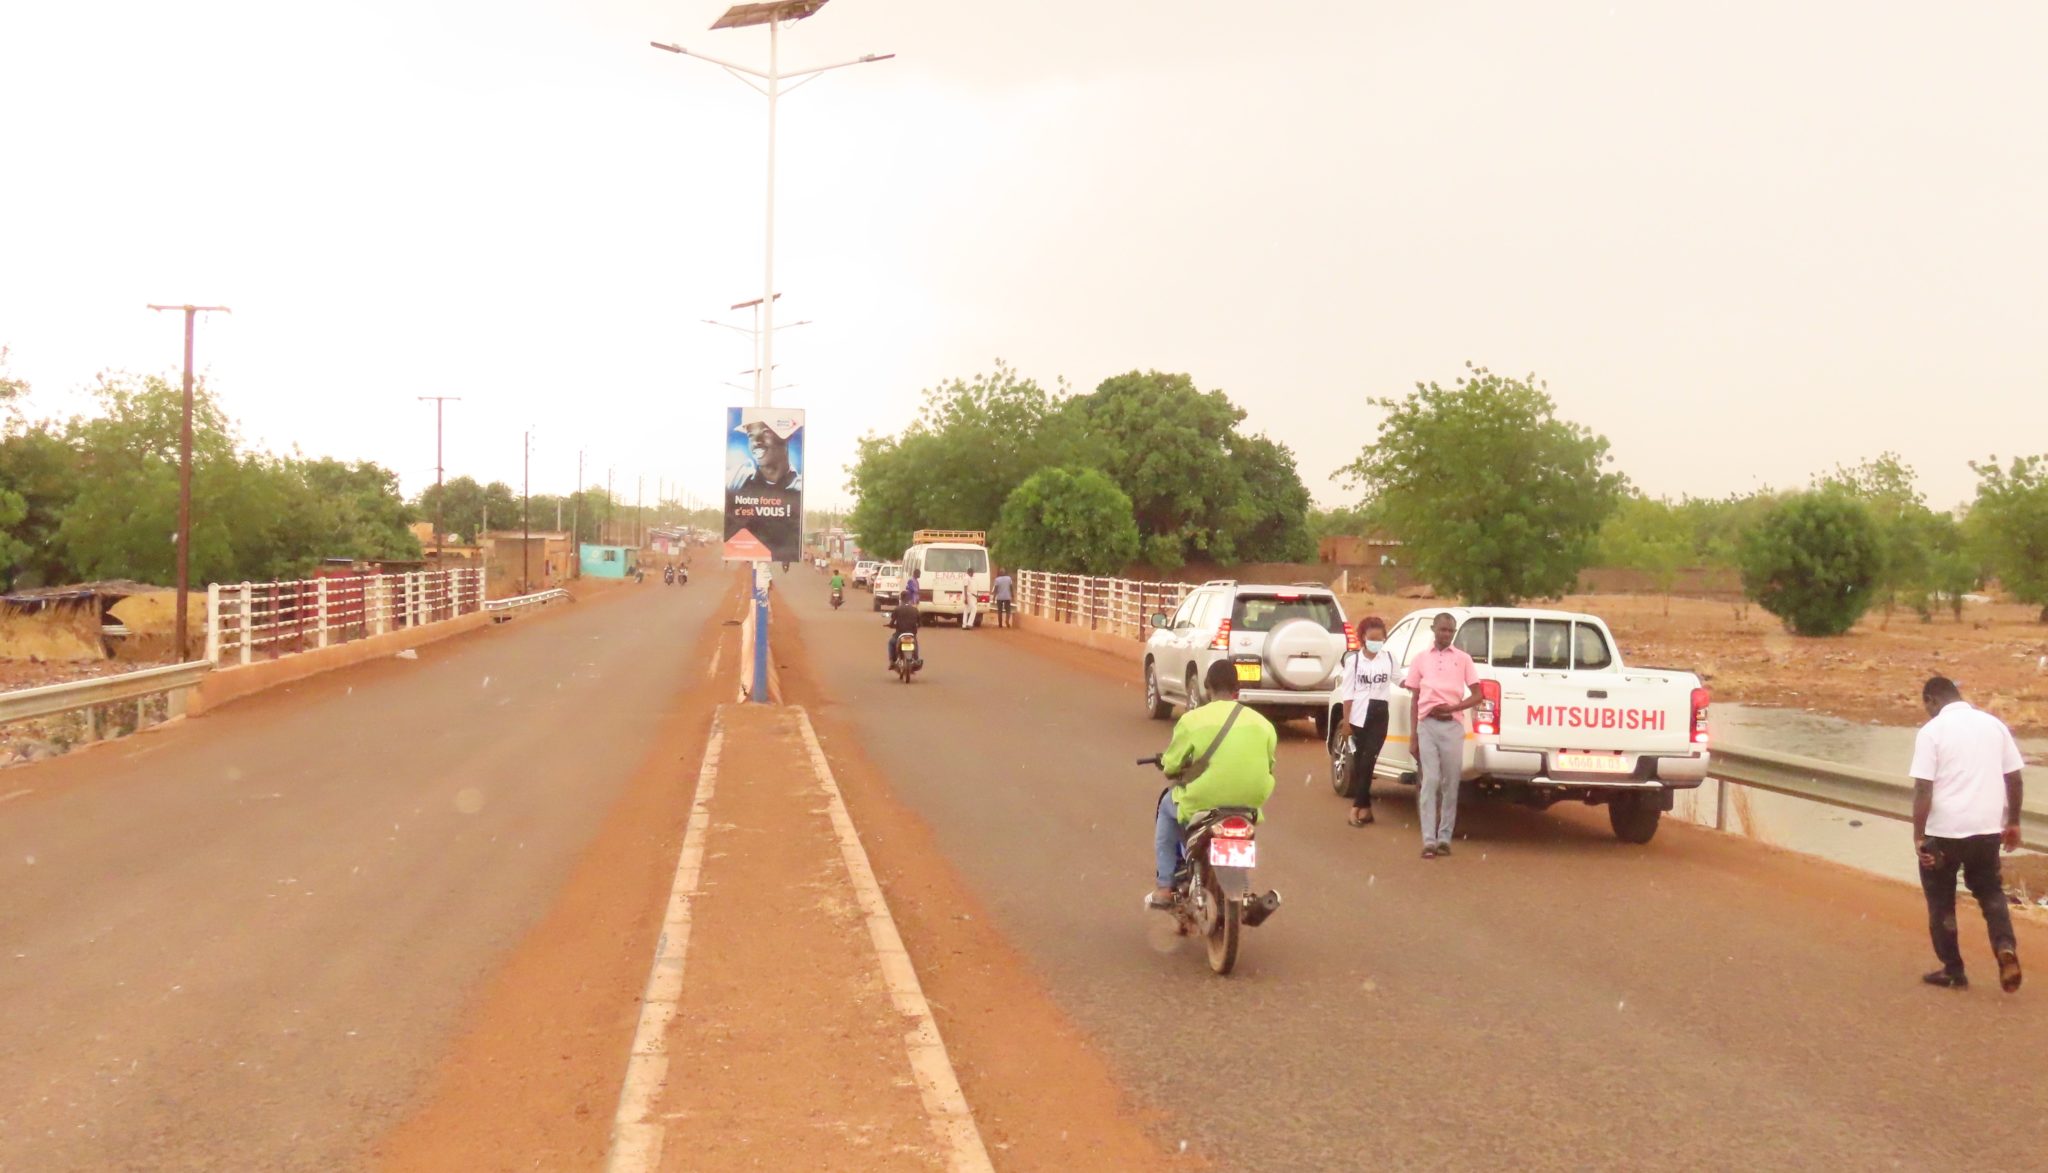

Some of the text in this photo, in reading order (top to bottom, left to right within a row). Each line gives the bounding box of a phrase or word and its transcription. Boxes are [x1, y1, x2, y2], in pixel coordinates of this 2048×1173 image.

[735, 495, 782, 505] Notre force
[735, 507, 754, 516] c'est
[1526, 705, 1665, 730] MITSUBISHI
